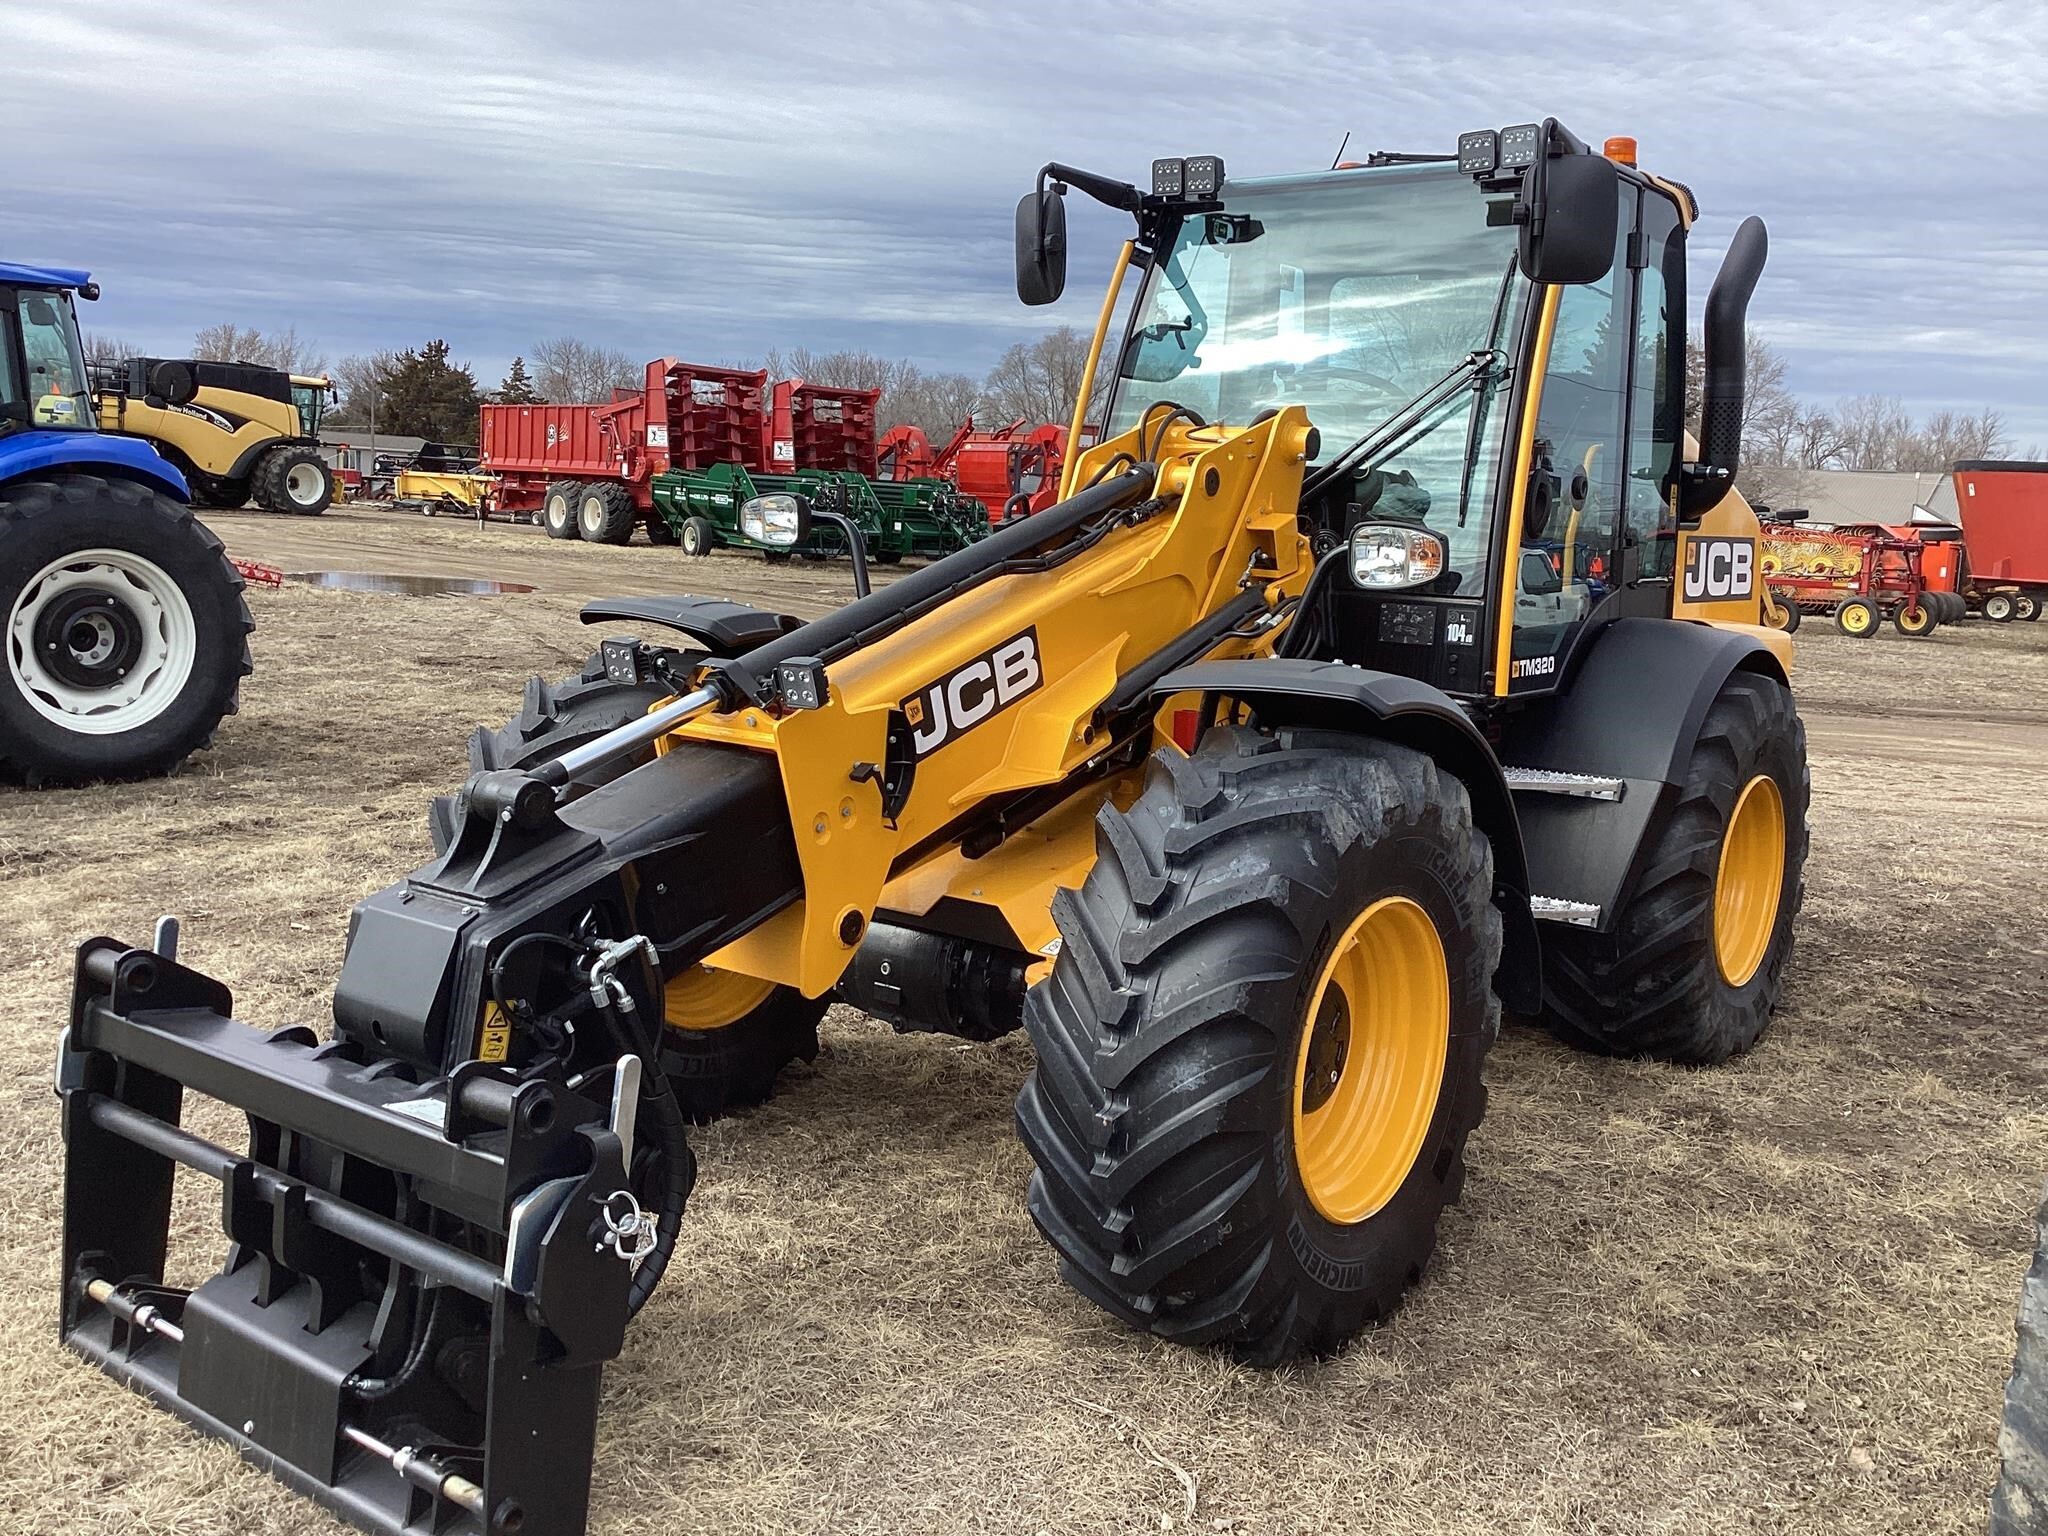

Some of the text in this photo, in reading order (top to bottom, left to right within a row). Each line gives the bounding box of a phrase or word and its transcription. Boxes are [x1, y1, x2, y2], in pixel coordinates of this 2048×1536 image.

[166, 403, 208, 421] New Holland
[1685, 541, 1753, 597] JCB
[1447, 623, 1466, 642] 104
[1520, 656, 1555, 677] TM320
[913, 635, 1039, 755] JCB
[1286, 1220, 1364, 1290] MICHELIN
